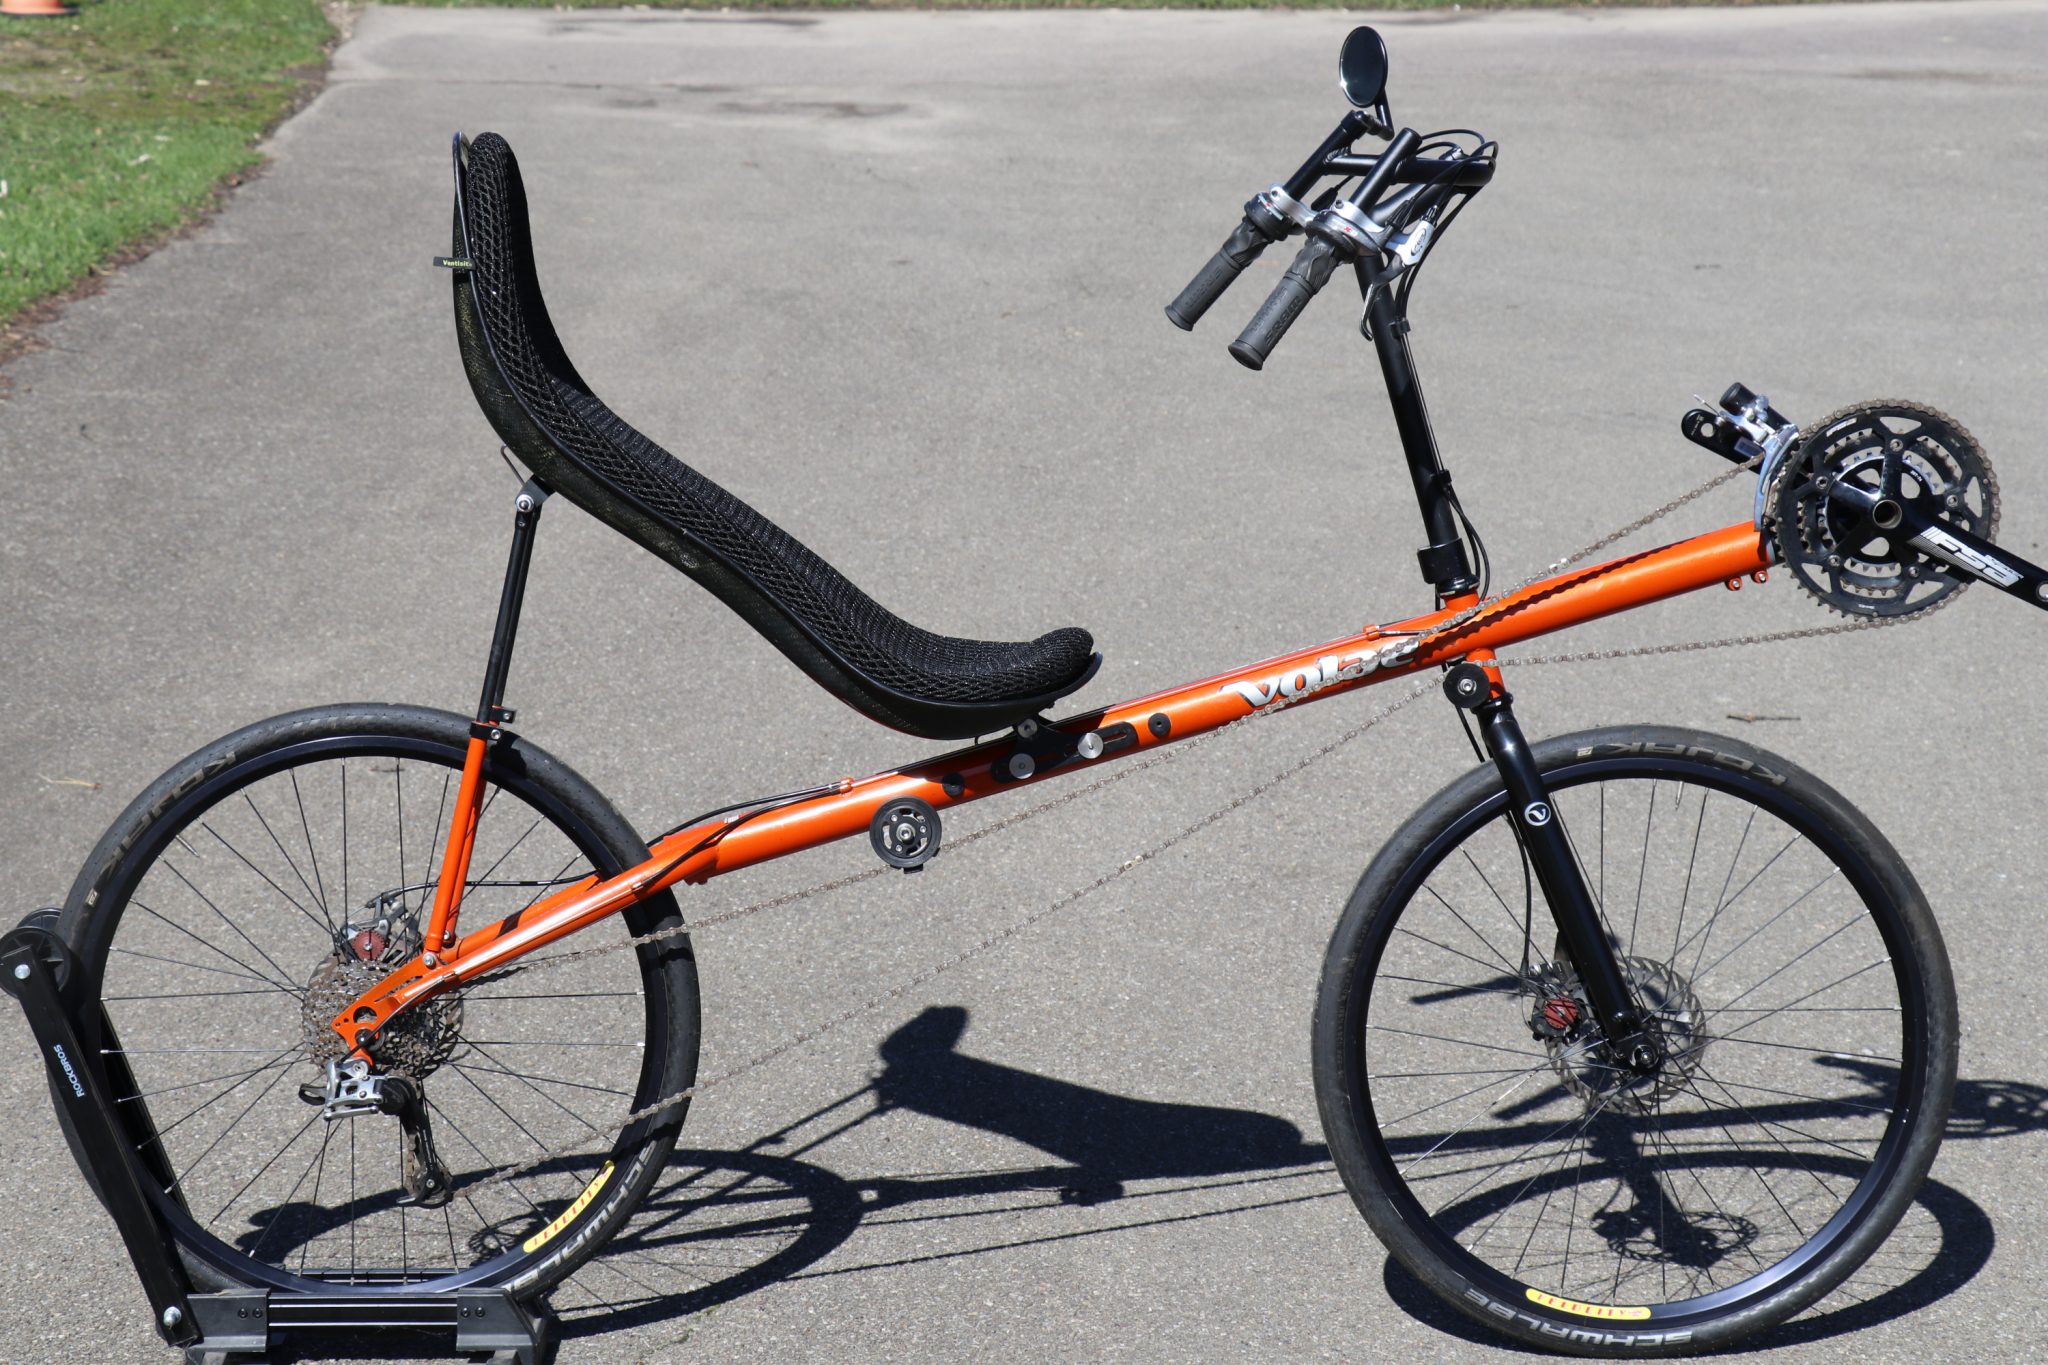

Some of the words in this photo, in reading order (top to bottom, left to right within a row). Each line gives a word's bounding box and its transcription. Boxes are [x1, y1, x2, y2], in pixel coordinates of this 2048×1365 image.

[442, 259, 469, 267] Ventisit
[1604, 741, 1788, 786] KOJAK
[98, 752, 236, 880] KOJAK
[53, 1044, 86, 1098] ROCKBROS
[1464, 1287, 1693, 1347] SCHWALBE
